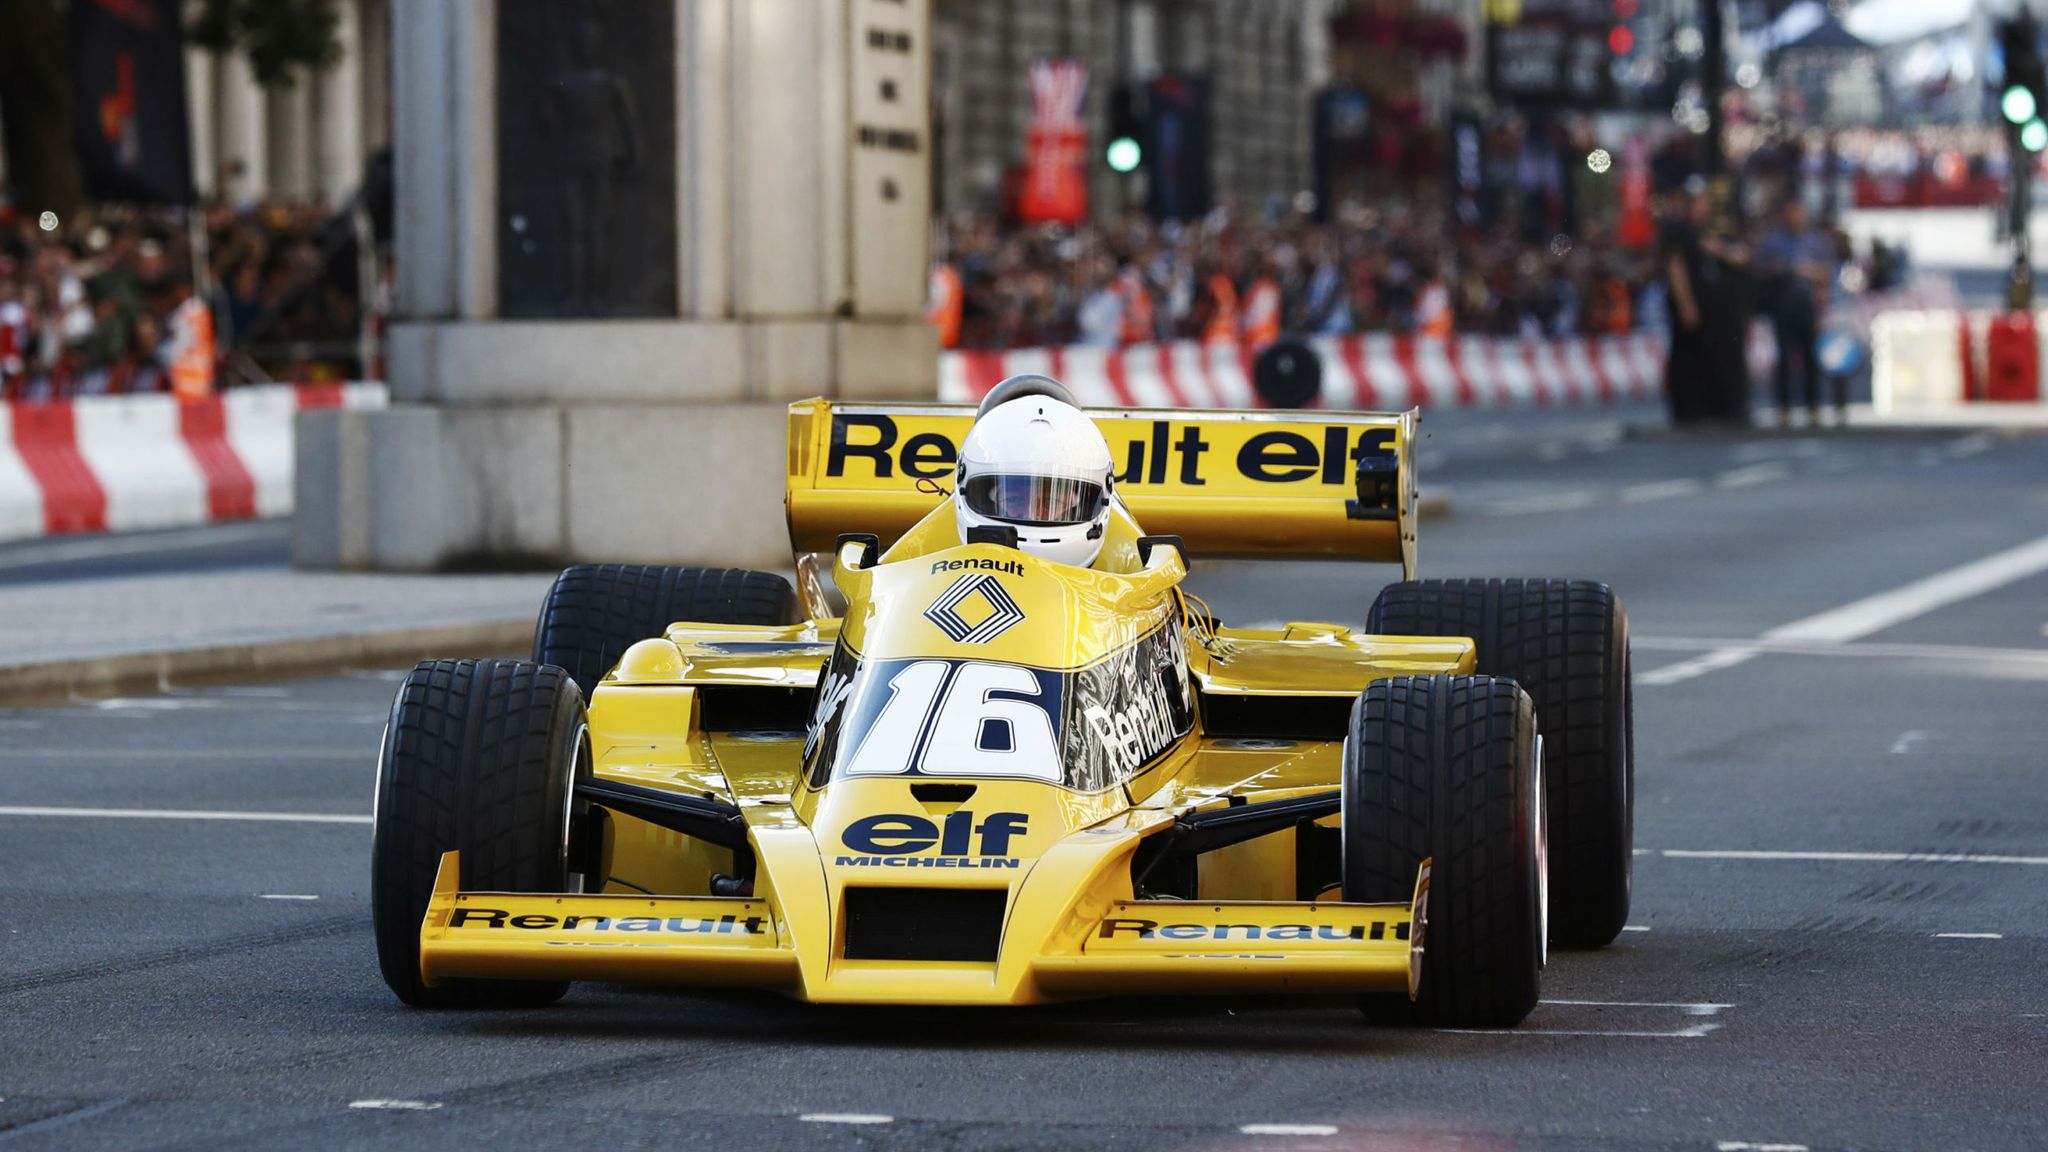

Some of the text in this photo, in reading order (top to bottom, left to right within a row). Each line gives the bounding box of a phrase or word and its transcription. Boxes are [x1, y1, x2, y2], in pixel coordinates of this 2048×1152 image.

[826, 414, 1396, 486] Reult elf
[931, 559, 1025, 577] Renault
[846, 661, 1064, 783] 16
[1083, 671, 1179, 781] Renault
[842, 811, 1029, 856] elf
[835, 857, 1020, 869] MICHELIN
[448, 908, 768, 935] Renault
[1099, 919, 1410, 941] Renault
